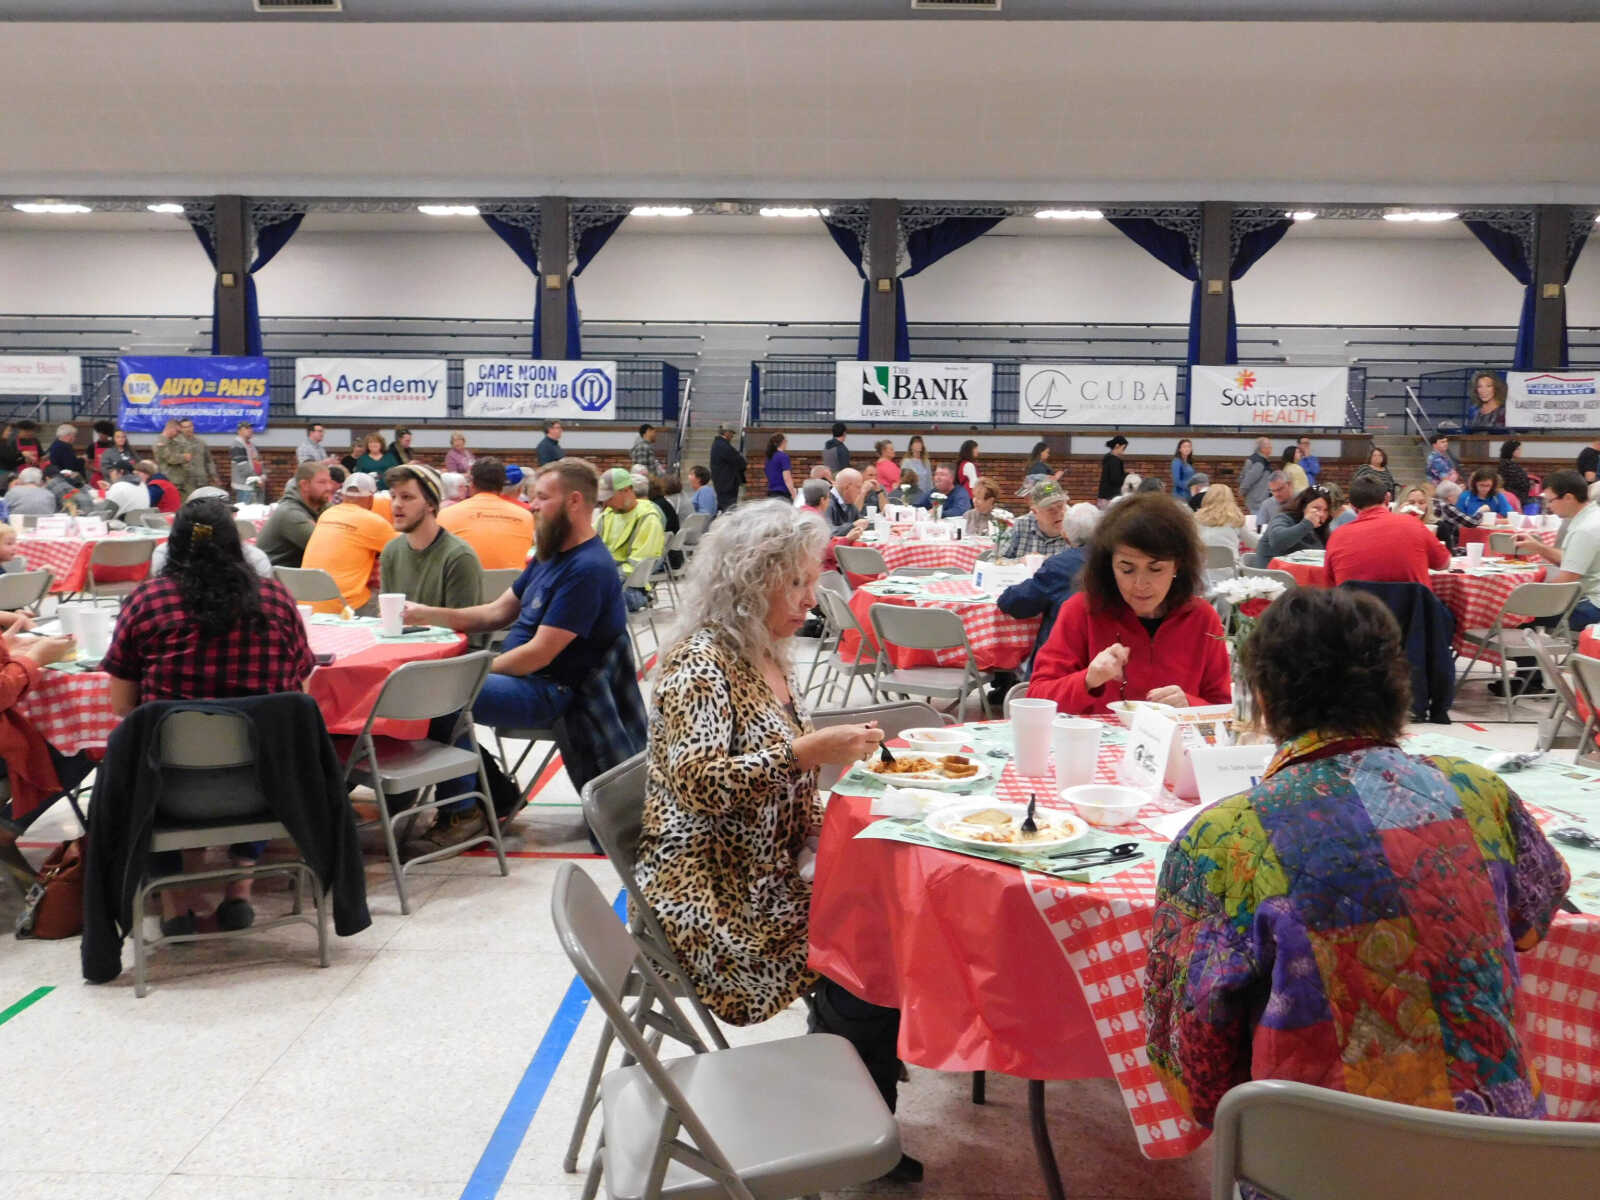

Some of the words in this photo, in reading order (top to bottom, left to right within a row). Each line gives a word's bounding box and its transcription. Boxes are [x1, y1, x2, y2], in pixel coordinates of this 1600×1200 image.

[479, 364, 514, 380] CAPE
[518, 365, 558, 381] NOON
[892, 366, 909, 375] THE
[160, 378, 204, 397] AUTO
[217, 378, 266, 397] PARTS
[336, 373, 438, 399] Academy
[466, 382, 530, 398] OPTIMIST
[534, 383, 568, 399] CLUB
[892, 374, 969, 401] BANK
[1080, 380, 1169, 401] CUBA
[1221, 388, 1317, 407] Southeast
[861, 408, 880, 417] LIVE
[912, 409, 938, 417] BANK
[1252, 409, 1317, 423] HEALTH
